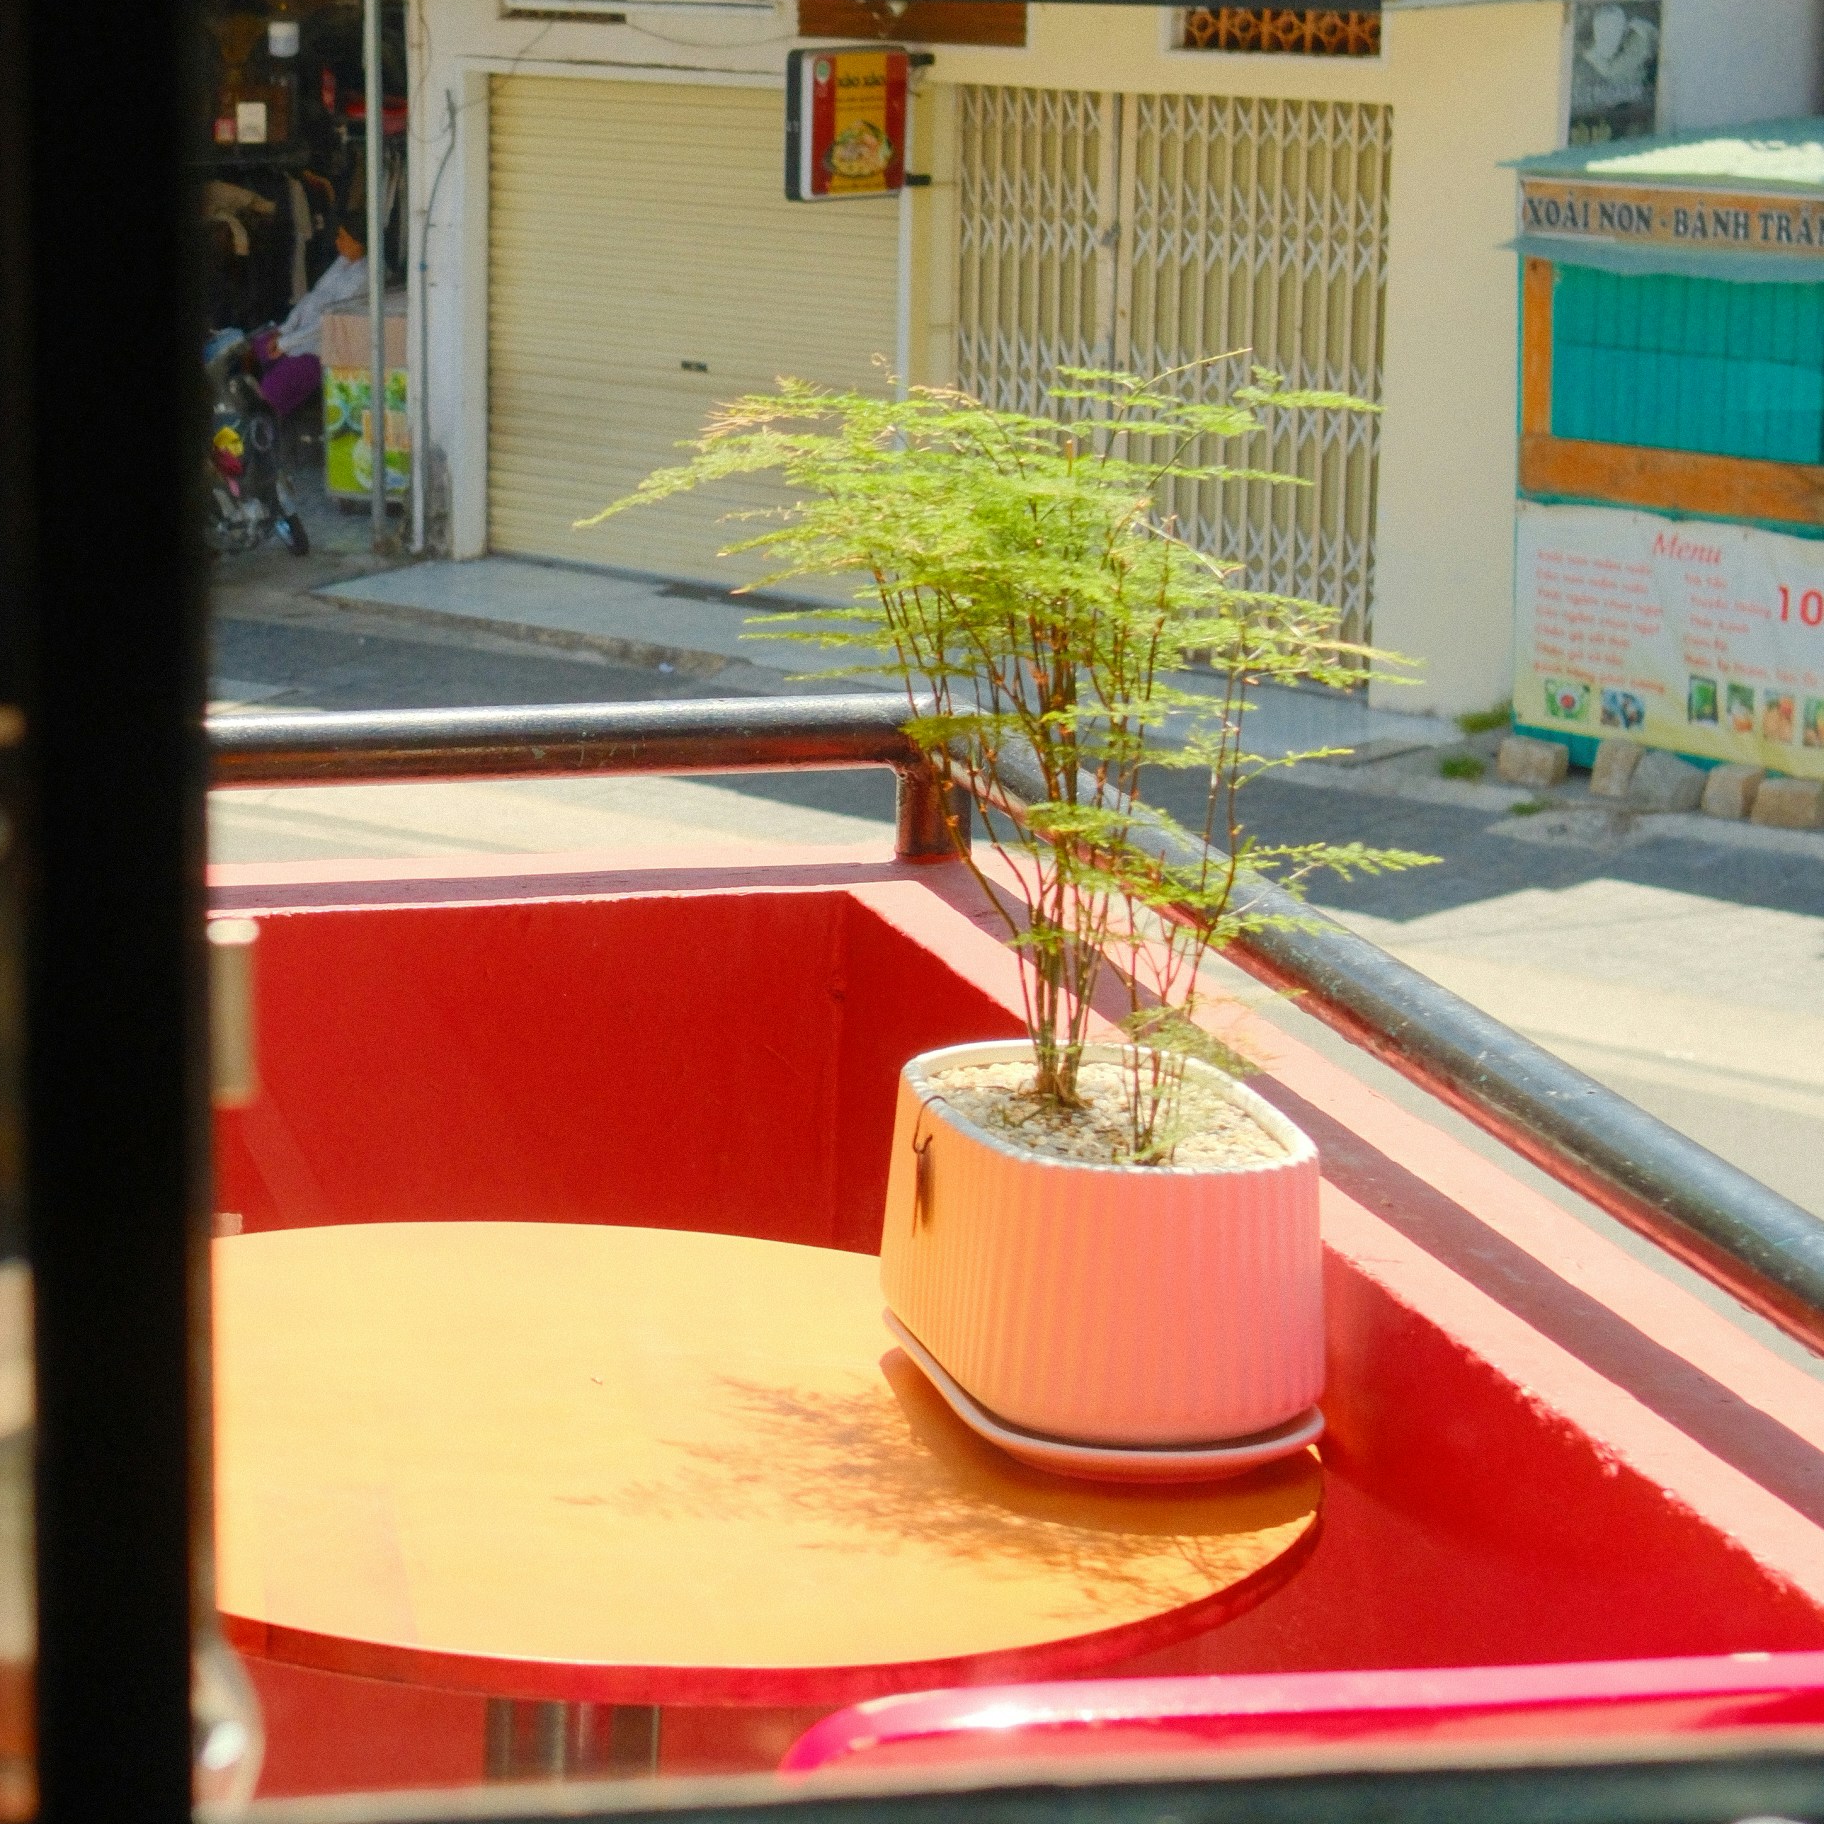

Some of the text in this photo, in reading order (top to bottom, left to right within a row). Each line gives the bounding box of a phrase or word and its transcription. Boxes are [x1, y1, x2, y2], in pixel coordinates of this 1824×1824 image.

[1527, 190, 1589, 230] XOÀI
[1599, 200, 1654, 234] NON
[1673, 200, 1750, 241] BÁNH
[1652, 531, 1722, 565] Menu
